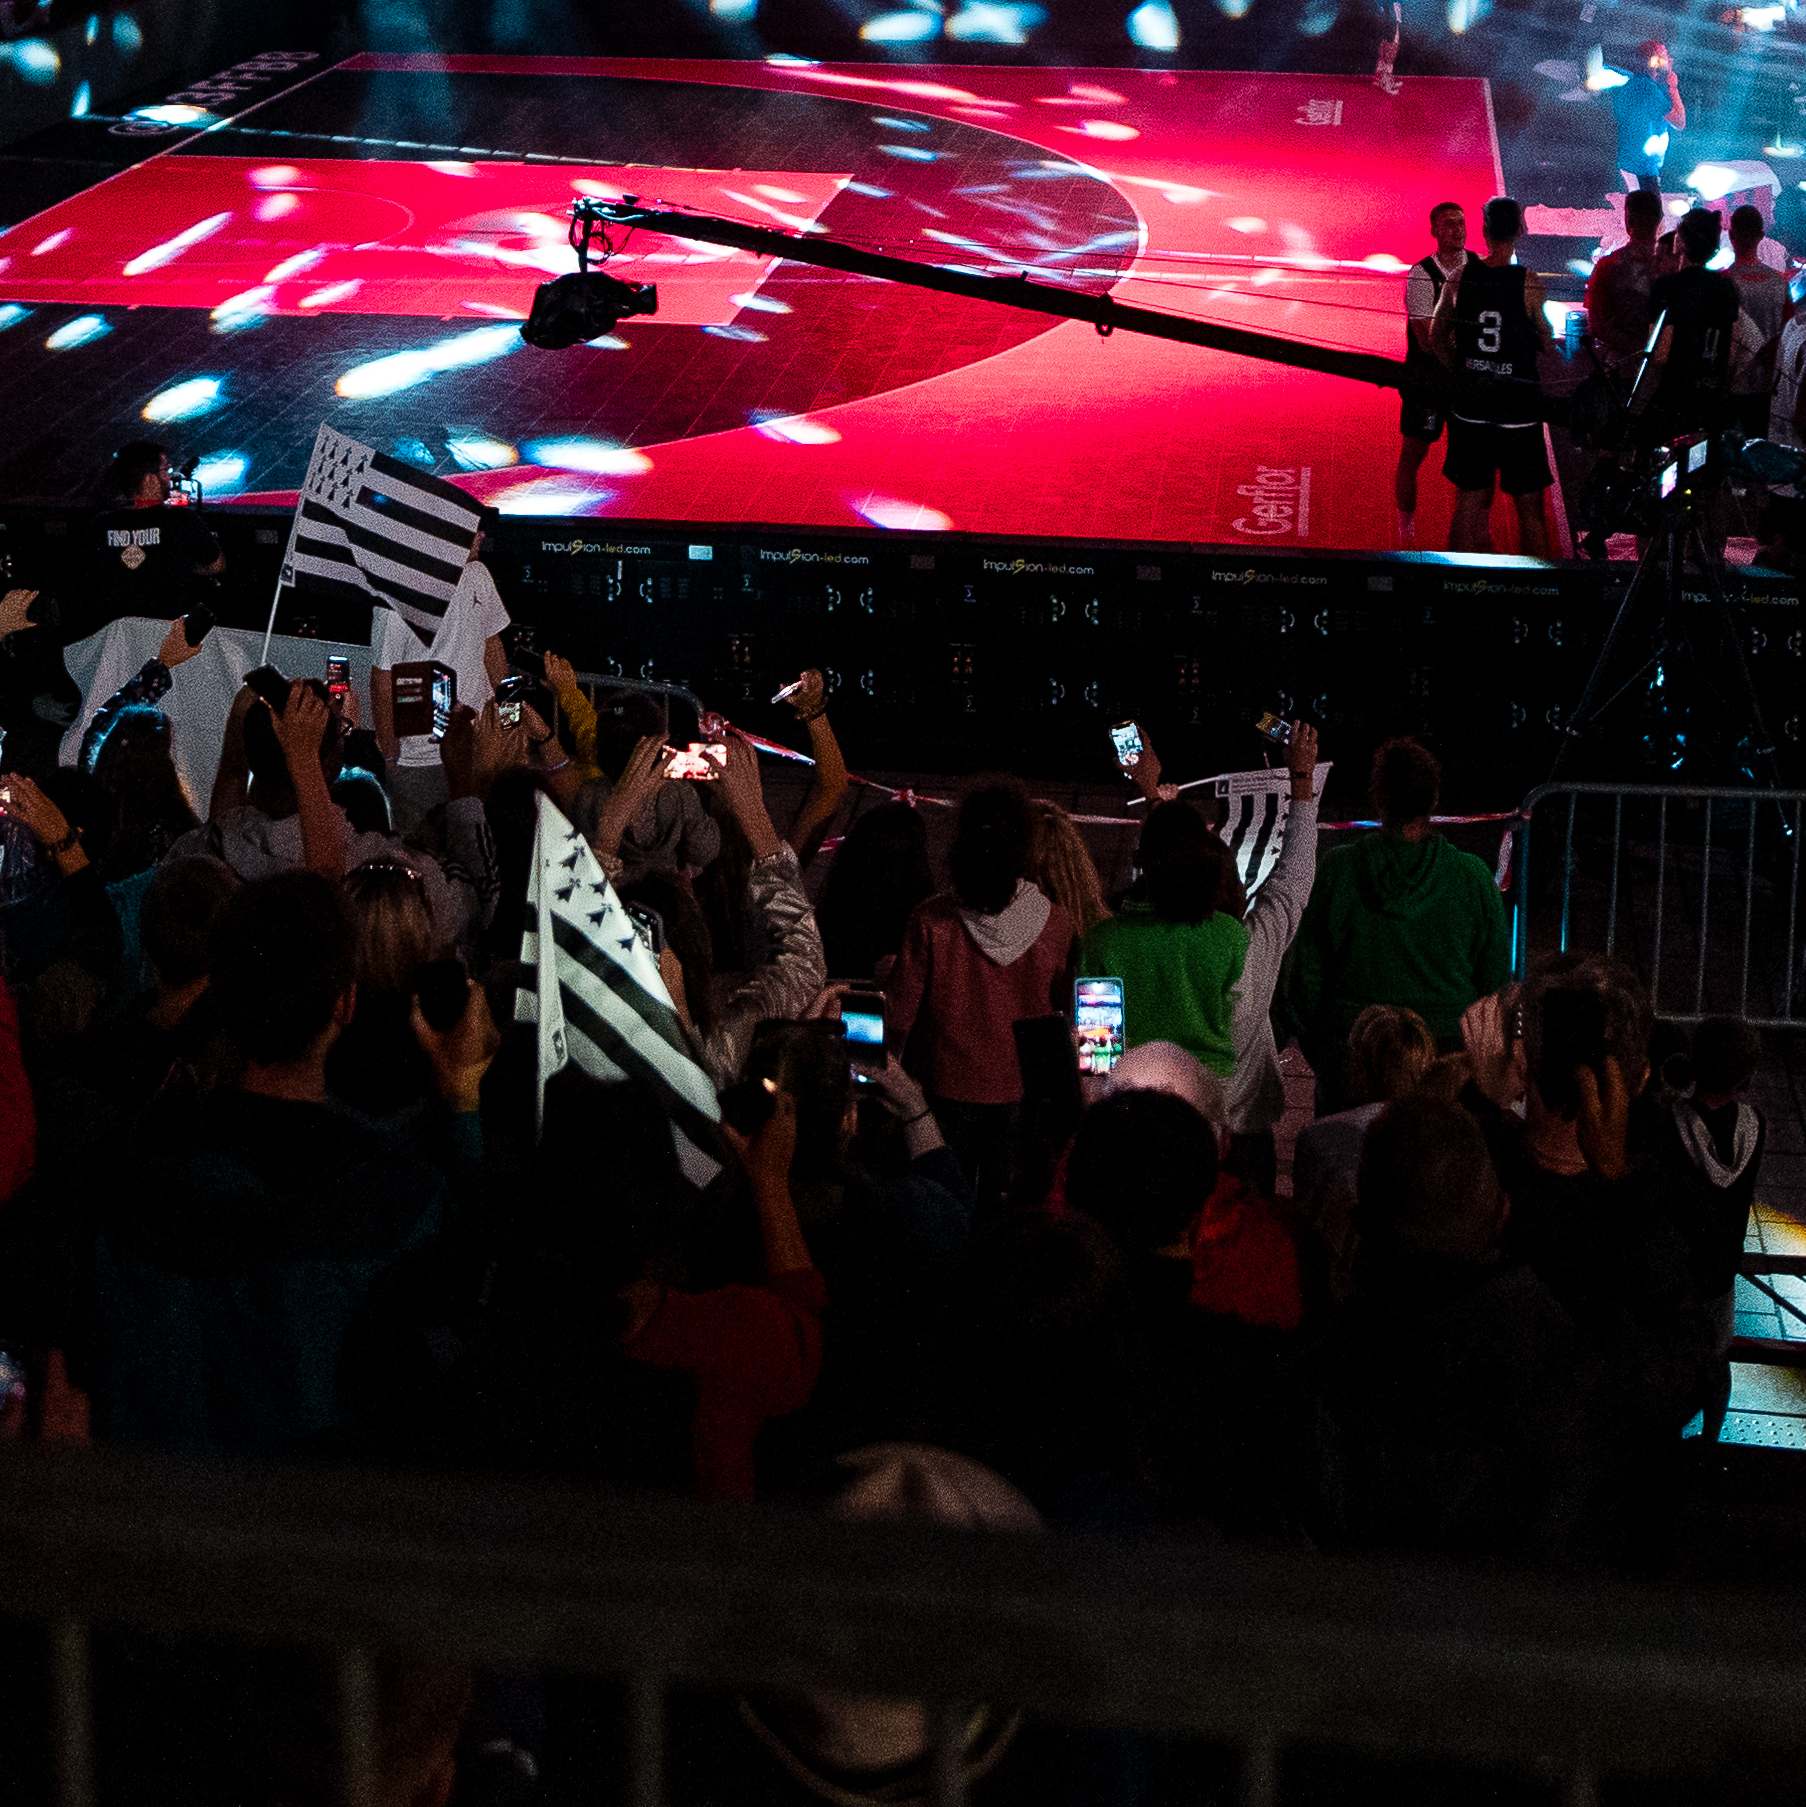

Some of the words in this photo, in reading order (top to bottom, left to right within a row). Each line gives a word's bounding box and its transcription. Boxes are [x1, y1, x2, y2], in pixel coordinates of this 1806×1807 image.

[1477, 309, 1503, 354] 3
[1230, 463, 1301, 536] Gerflor
[106, 528, 130, 548] FIND
[132, 526, 162, 547] YOUR
